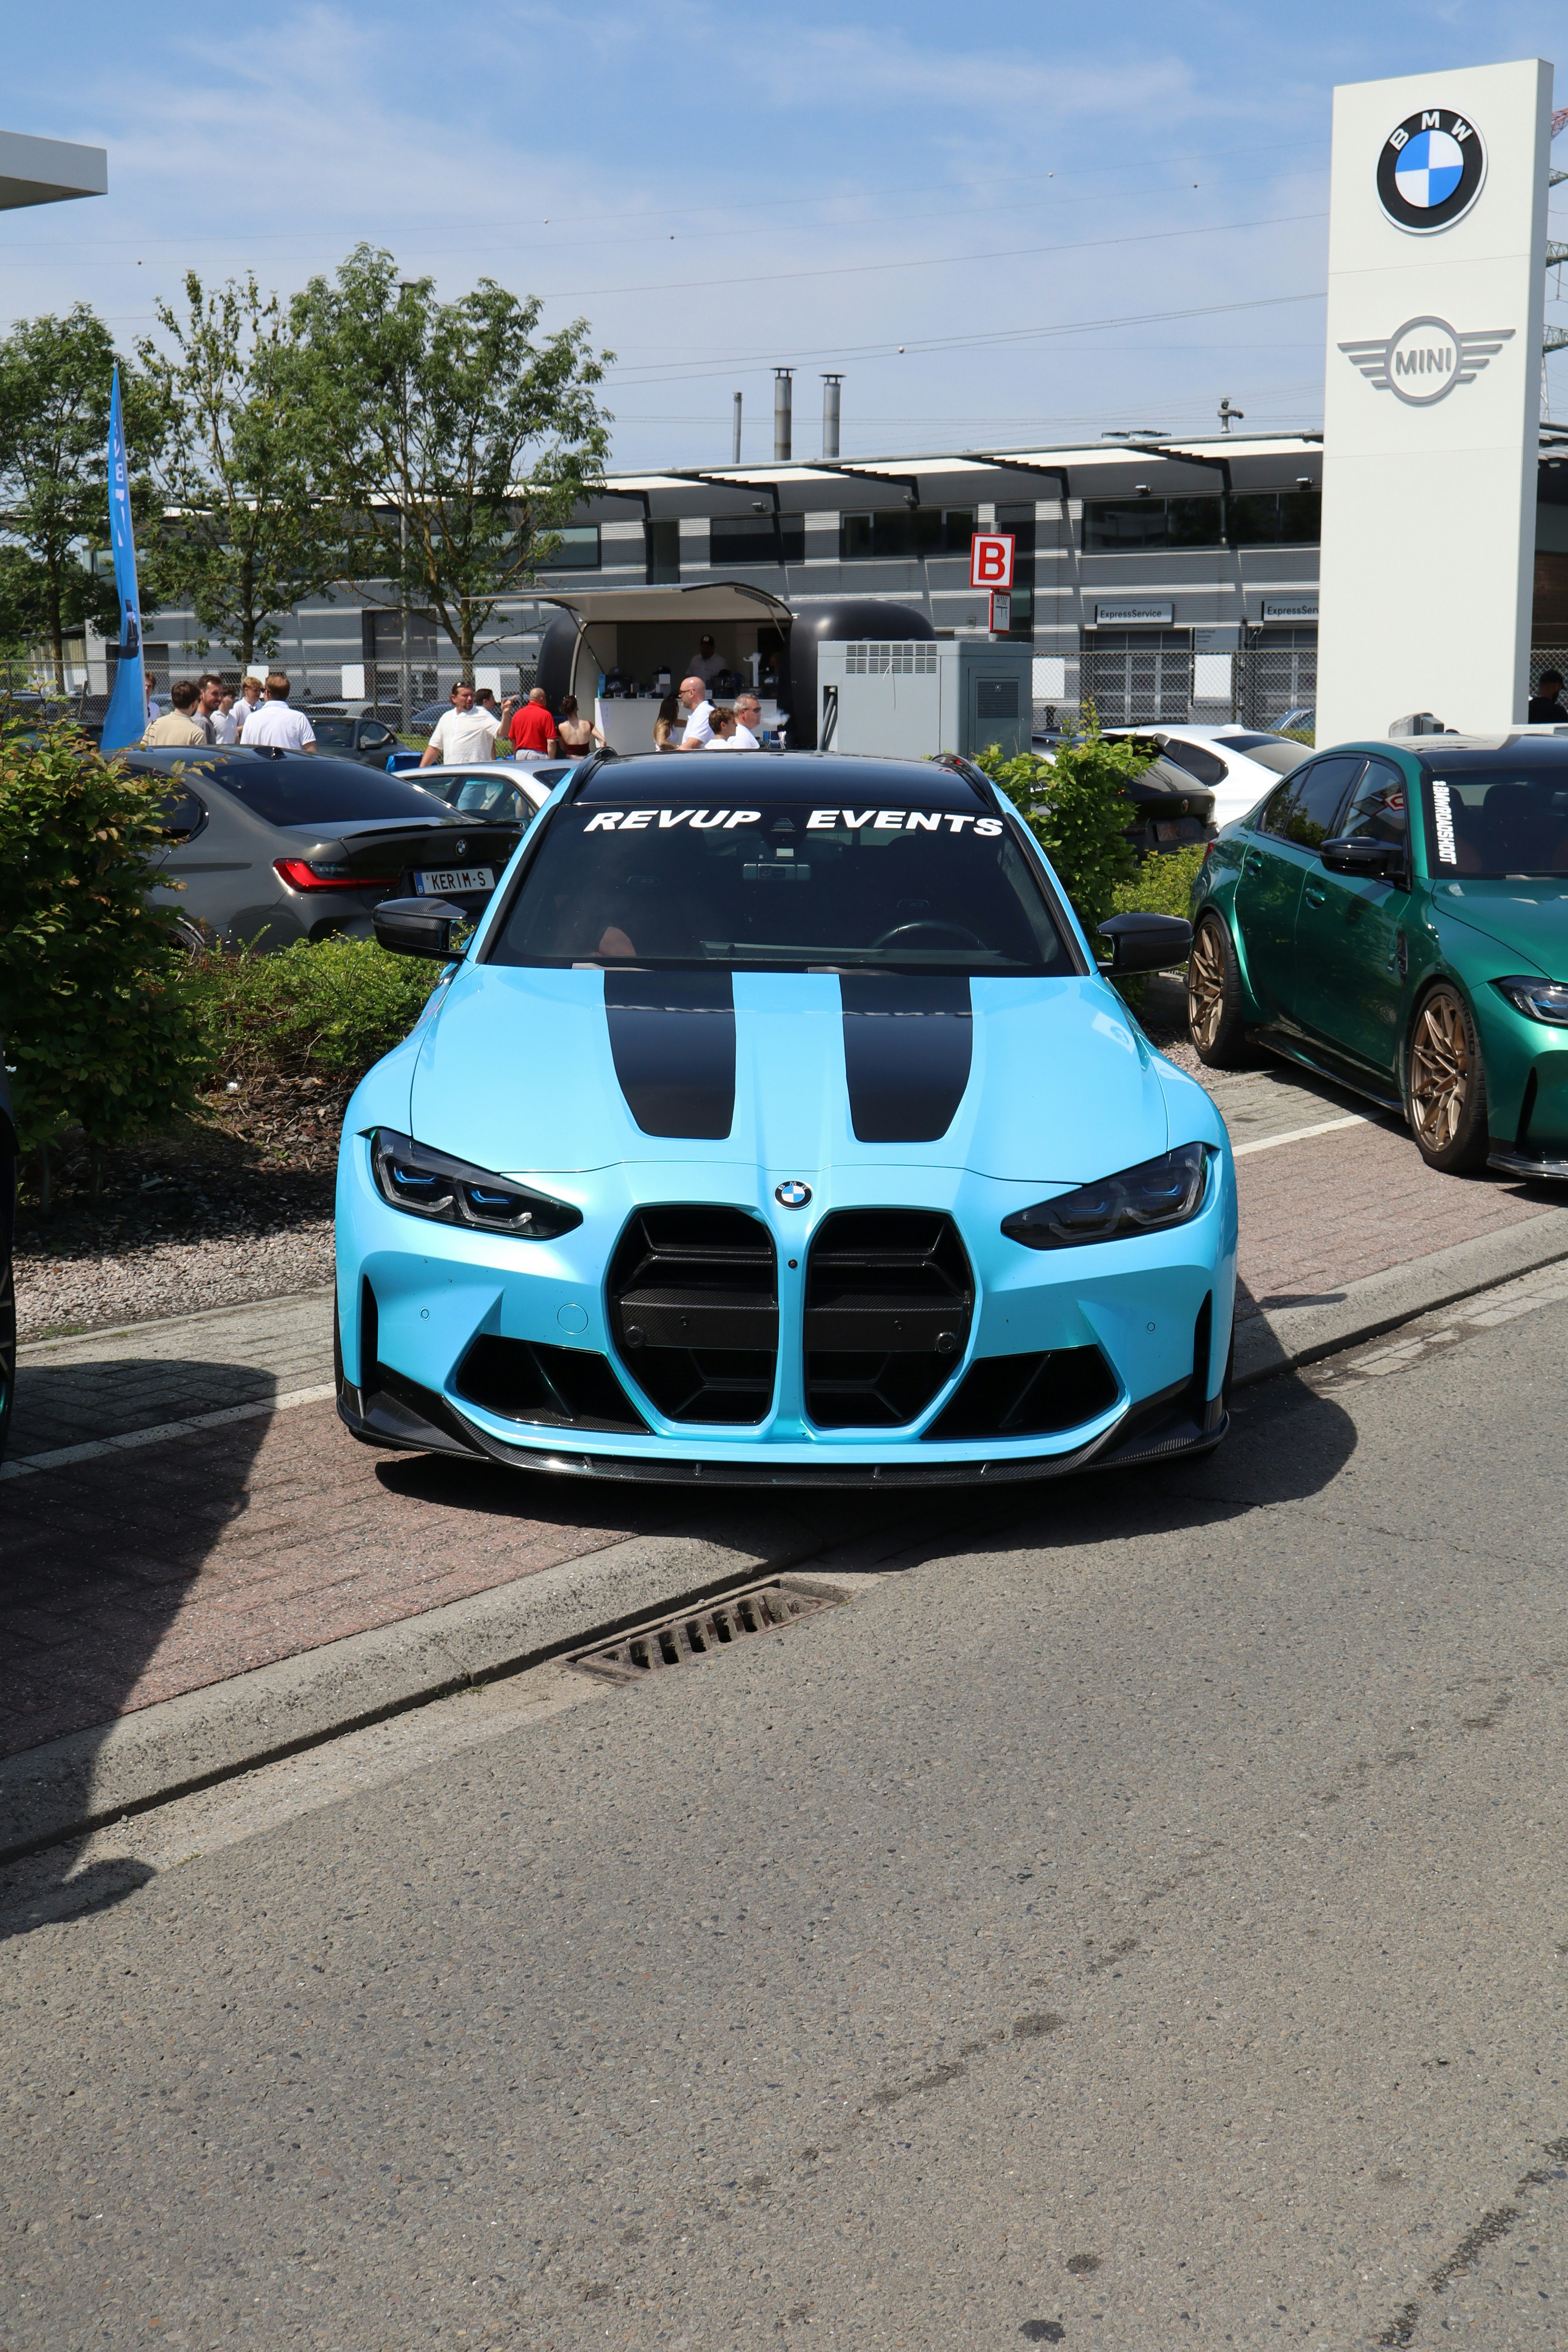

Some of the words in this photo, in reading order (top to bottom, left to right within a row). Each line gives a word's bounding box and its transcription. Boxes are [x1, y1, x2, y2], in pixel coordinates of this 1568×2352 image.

[1389, 111, 1472, 151] BMW
[1395, 347, 1452, 376] MINI
[978, 542, 1005, 580] B
[1100, 609, 1162, 621] ExpressService
[583, 810, 761, 832] REVUP
[806, 810, 1004, 837] EVENTS
[1432, 780, 1457, 865] #BMWROADSHOOT
[778, 1180, 809, 1190] BMW
